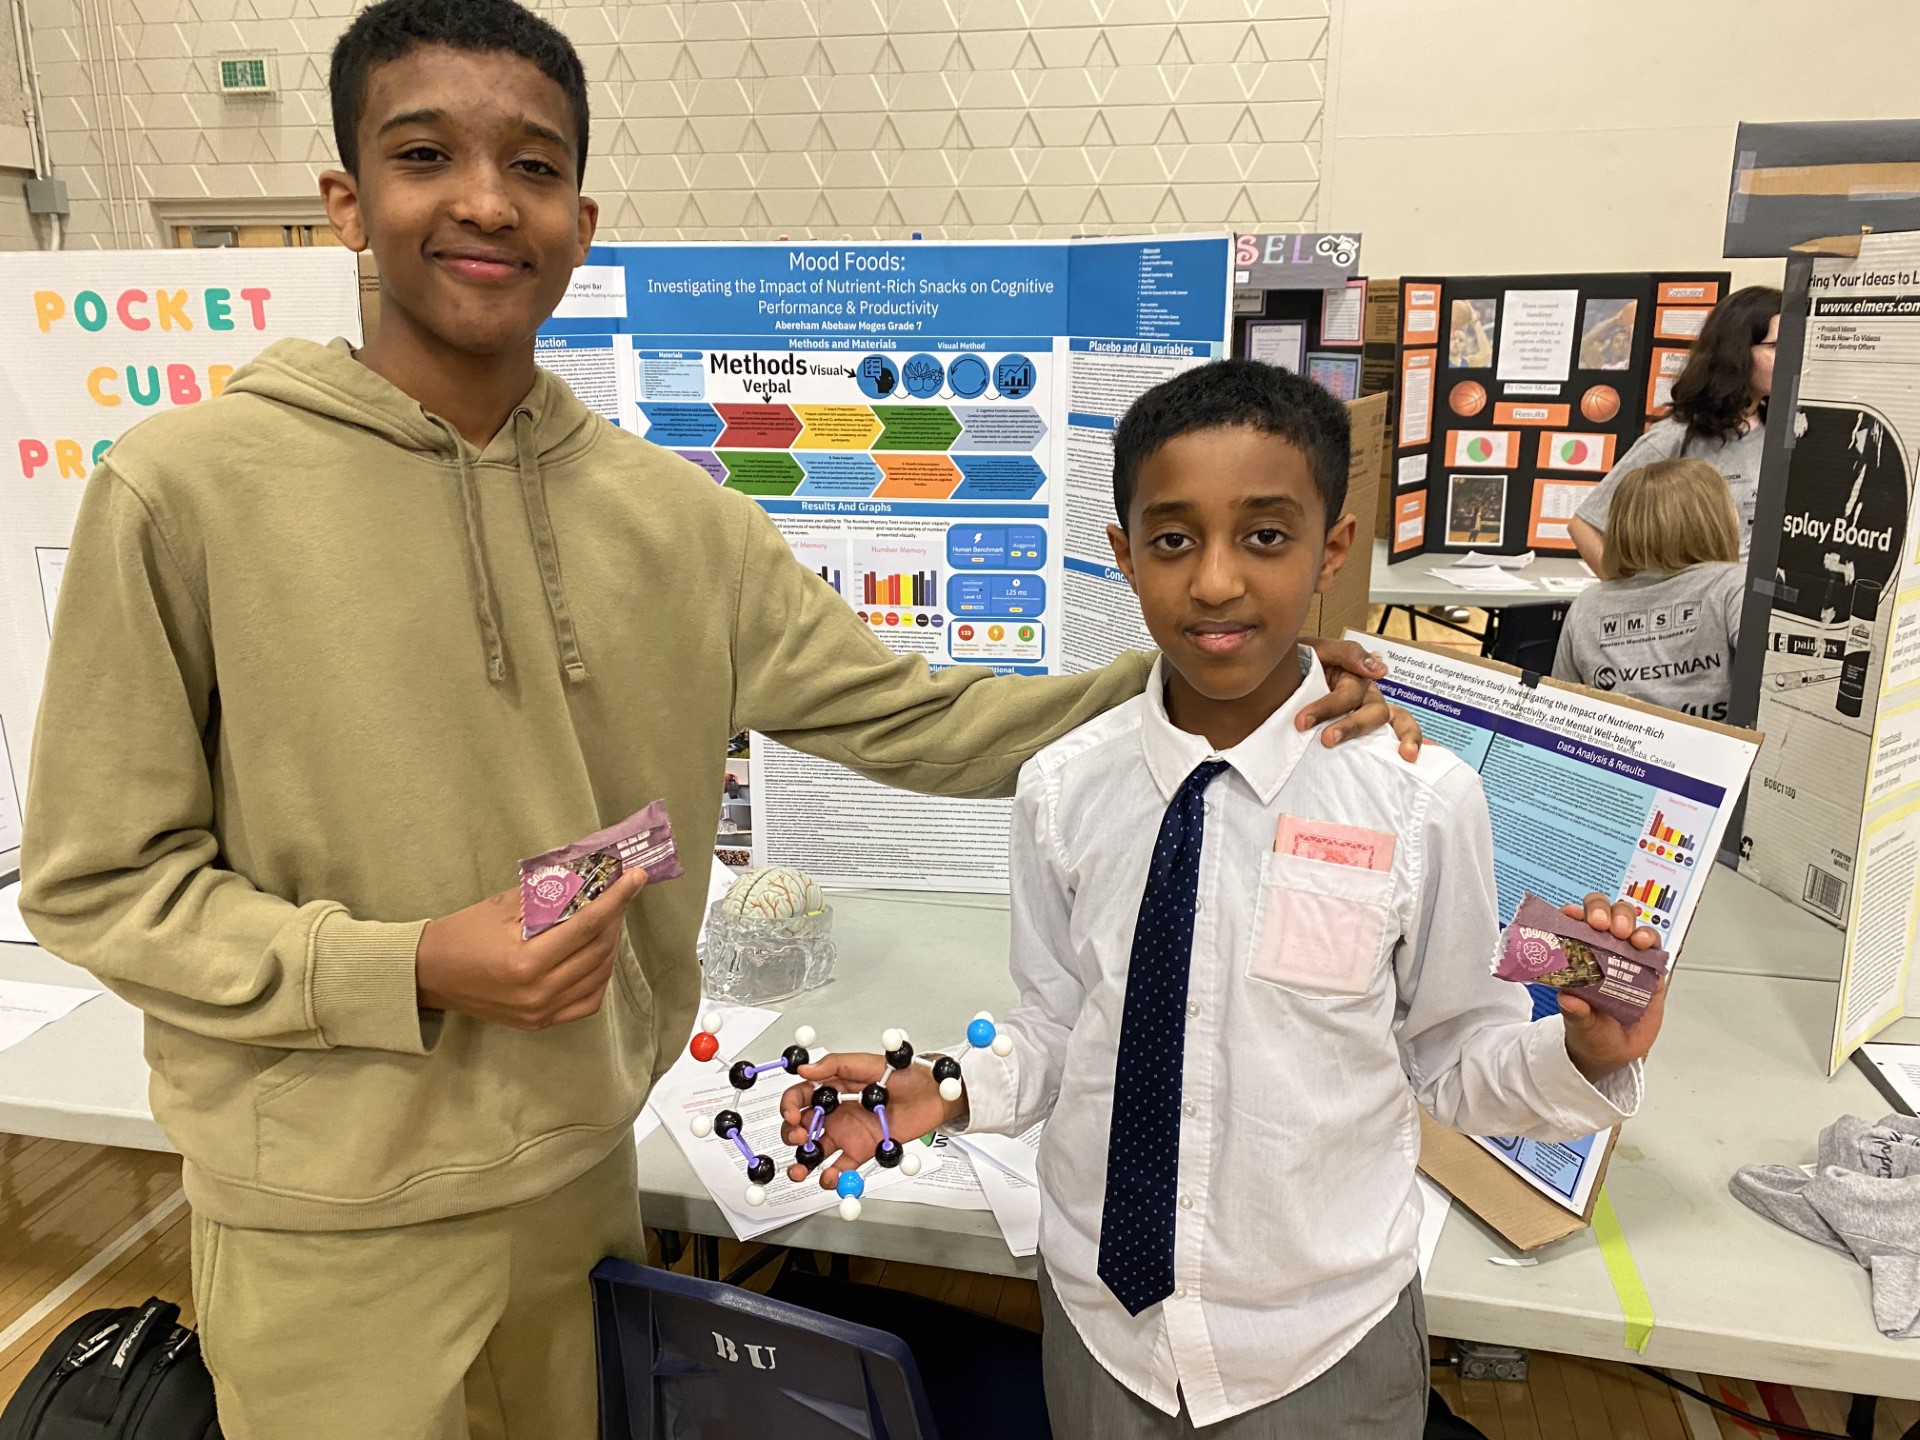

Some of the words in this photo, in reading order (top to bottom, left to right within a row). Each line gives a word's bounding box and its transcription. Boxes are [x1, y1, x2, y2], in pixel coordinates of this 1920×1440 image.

[789, 252, 838, 270] Mood
[844, 252, 906, 270] Foods:
[648, 278, 732, 296] Investigating
[734, 278, 755, 293] the
[759, 279, 805, 296] Impact
[810, 278, 822, 293] of
[826, 278, 916, 294] Nutrient-Rich
[920, 278, 966, 294] Snacks
[970, 282, 987, 294] on
[990, 279, 1054, 296] Cognitive
[1832, 274, 1861, 288] Your
[1862, 272, 1895, 286] Ideas
[1898, 274, 1910, 285] to
[34, 287, 271, 332] POCKET
[758, 300, 843, 315] Performance
[846, 301, 854, 314] &
[860, 300, 938, 318] Productivity
[1820, 299, 1920, 313] www.elmers.com
[775, 320, 819, 330] Abereham
[822, 321, 857, 330] Abebaw
[858, 321, 886, 332] Moges
[888, 322, 914, 331] Grade
[916, 322, 922, 330] 7
[788, 339, 830, 349] Methods
[832, 340, 850, 349] and
[852, 340, 897, 350] Materials
[938, 342, 957, 350] Visual
[959, 342, 986, 350] Method
[1089, 340, 1120, 354] Placebo
[1122, 342, 1138, 354] and
[1140, 342, 1150, 354] All
[1152, 344, 1194, 356] variables
[710, 353, 807, 376] Methods
[810, 365, 844, 376] Visual
[743, 380, 791, 393] Verbal
[1514, 410, 1546, 418] Results
[802, 502, 835, 510] Results
[838, 502, 856, 511] And
[858, 503, 892, 514] Graphs
[1783, 512, 1831, 543] splay
[1832, 518, 1892, 552] Board
[1603, 620, 1617, 634] W
[1656, 614, 1666, 626] S
[1683, 608, 1694, 621] F
[1658, 631, 1684, 640] Science
[1619, 652, 1721, 682] WESTMAN
[1394, 666, 1415, 680] Snacks
[1416, 674, 1424, 682] on
[1425, 675, 1456, 692] Cognitive
[1456, 684, 1500, 706] Performance,
[1502, 699, 1548, 722] Productivity,
[1549, 715, 1564, 725] and
[1566, 718, 1593, 734] Mental
[1396, 688, 1423, 703] Problem
[1428, 698, 1461, 716] Objectives
[1407, 656, 1428, 670] Foods:
[1434, 664, 1485, 687] Comprehensive
[1485, 680, 1506, 696] Study
[1507, 686, 1554, 709] Investigating
[1554, 700, 1568, 711] the
[1569, 704, 1596, 720] Impact
[1597, 710, 1607, 722] of
[1607, 715, 1664, 740] Nutrient-Rich
[1535, 718, 1561, 732] Christian
[1562, 726, 1587, 740] Heritage
[1588, 733, 1614, 748] Brandon,
[1616, 742, 1648, 760] Manitoba,
[1649, 754, 1676, 769] Canada
[1557, 740, 1576, 754] Data
[1576, 746, 1608, 765] Analysis
[1608, 758, 1615, 766] &
[1616, 761, 1646, 778] Results
[712, 1331, 776, 1370] BU
